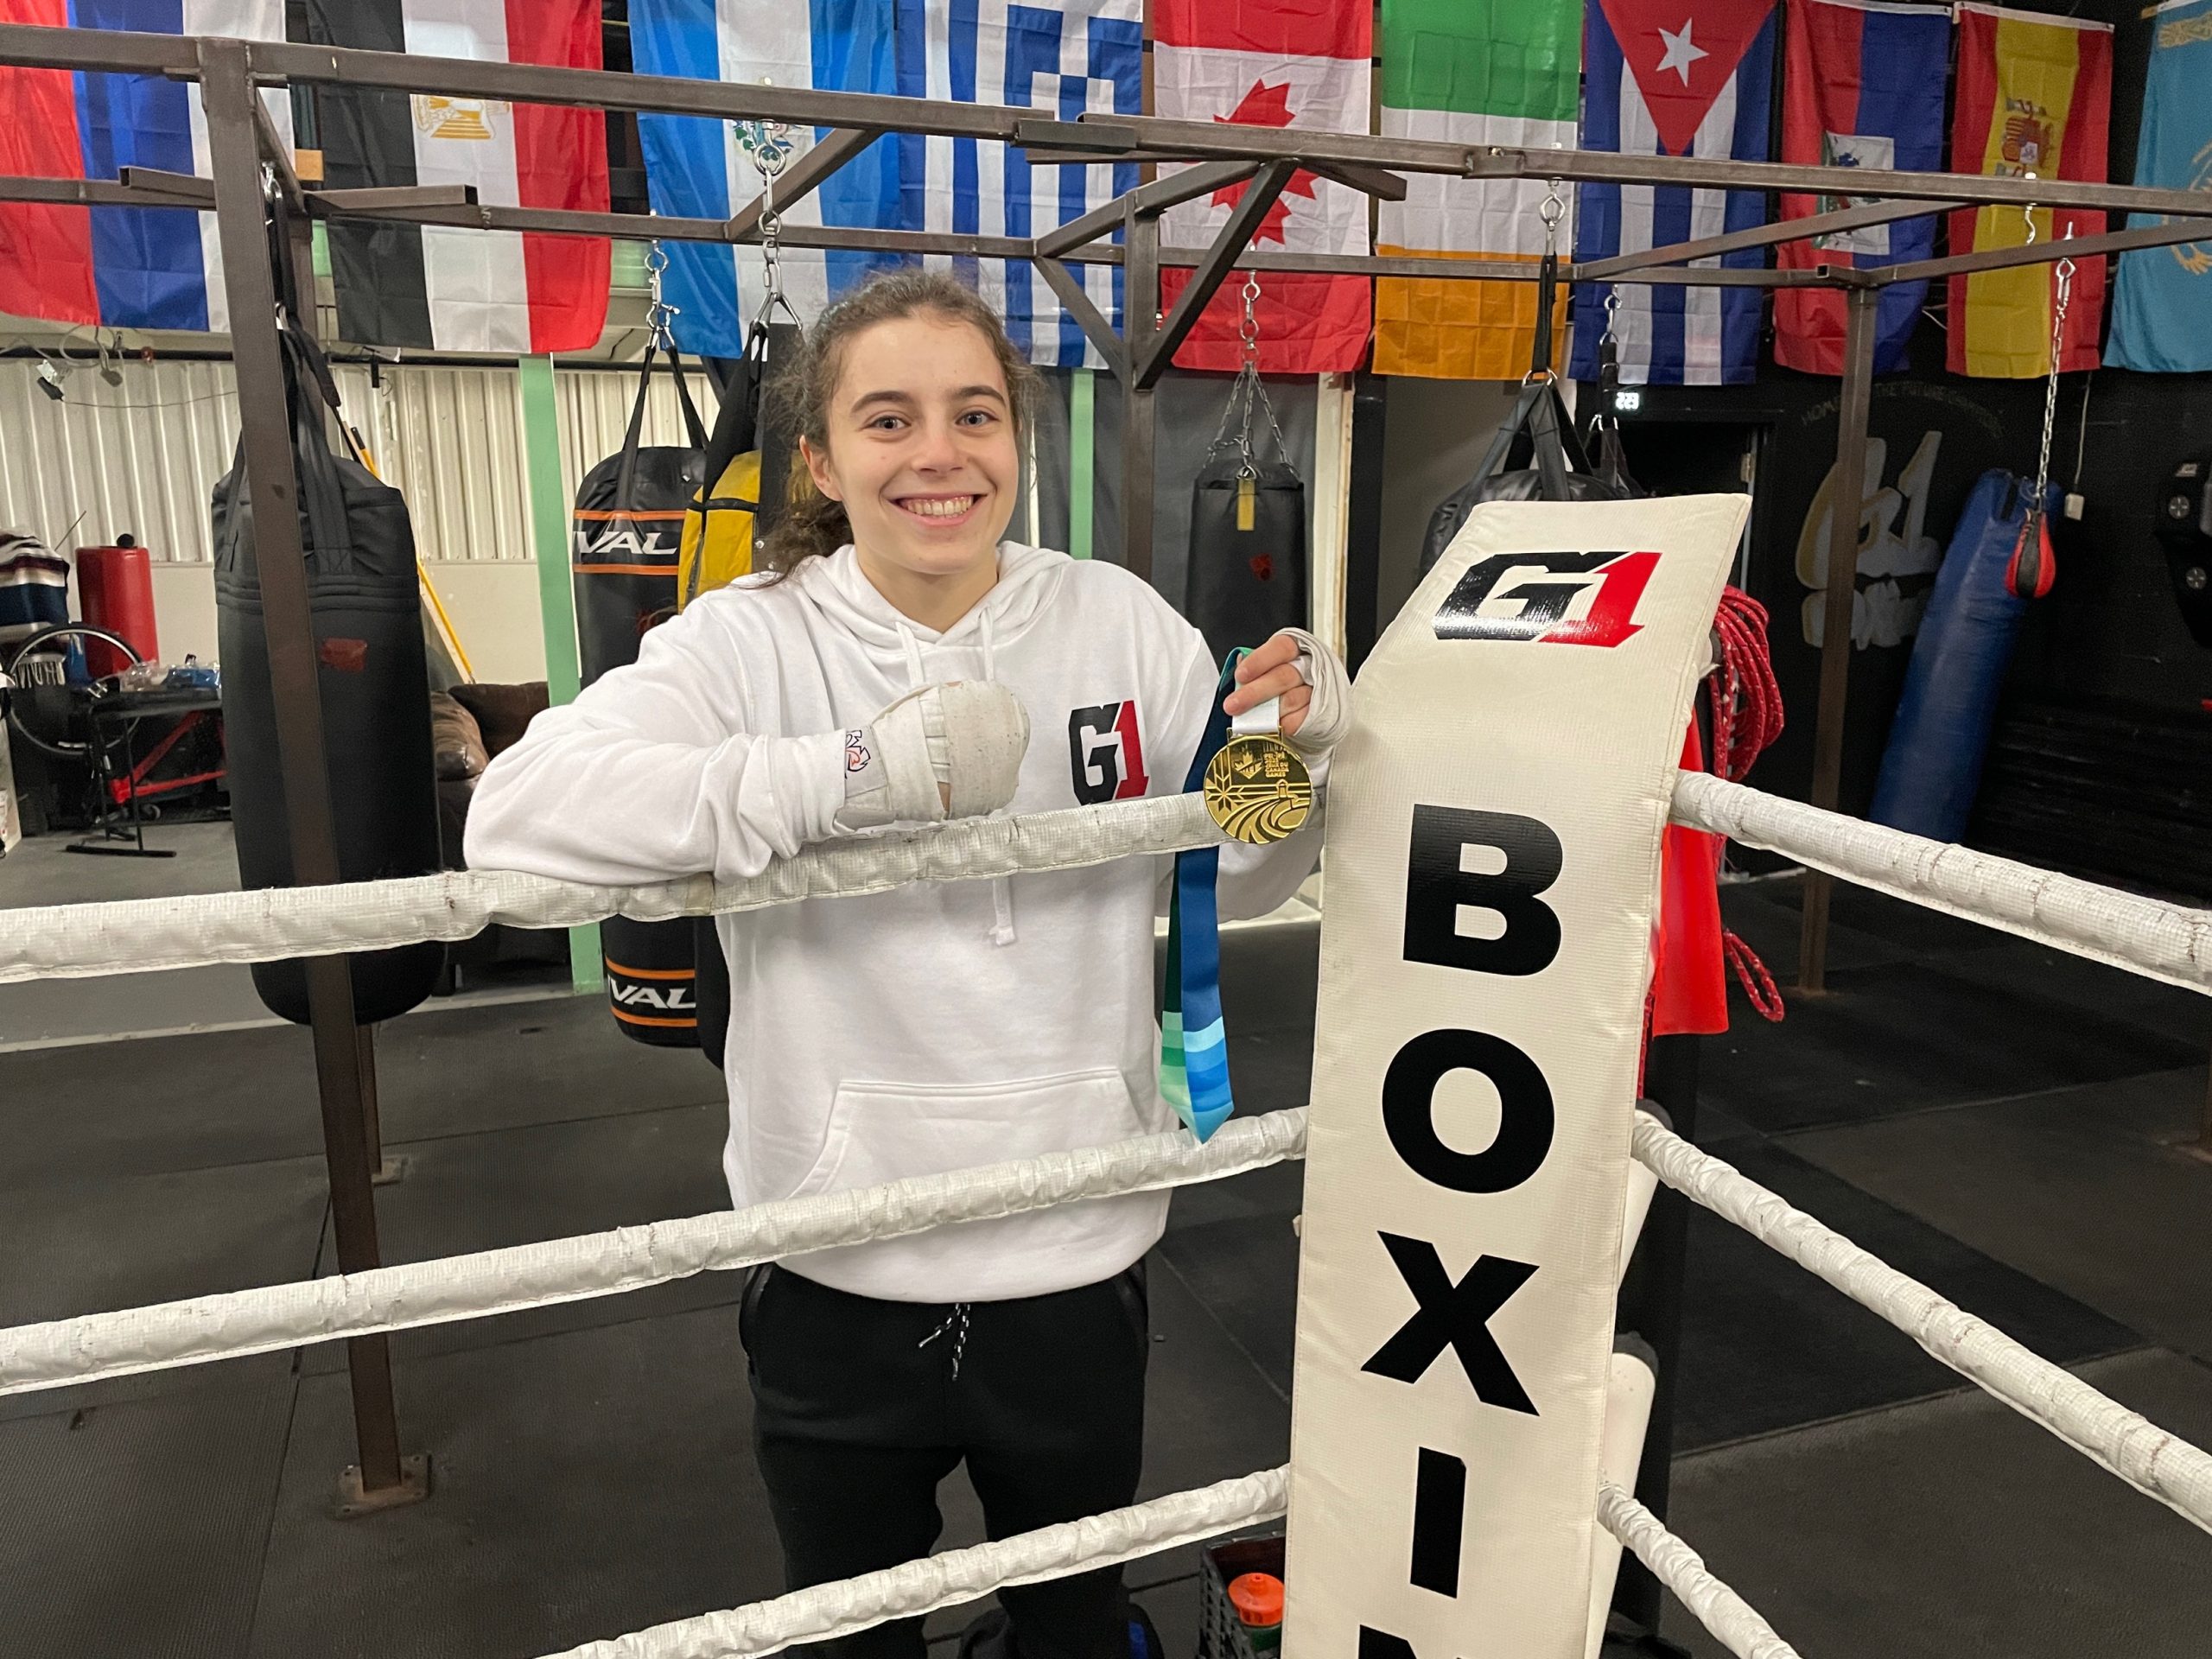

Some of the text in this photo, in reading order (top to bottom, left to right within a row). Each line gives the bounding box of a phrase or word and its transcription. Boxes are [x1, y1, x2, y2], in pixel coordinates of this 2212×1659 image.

[573, 531, 677, 555] VAL
[1433, 550, 1663, 648] G1
[1068, 699, 1150, 807] G1
[607, 974, 696, 1009] VAL
[1357, 804, 1563, 1659] BOXI
